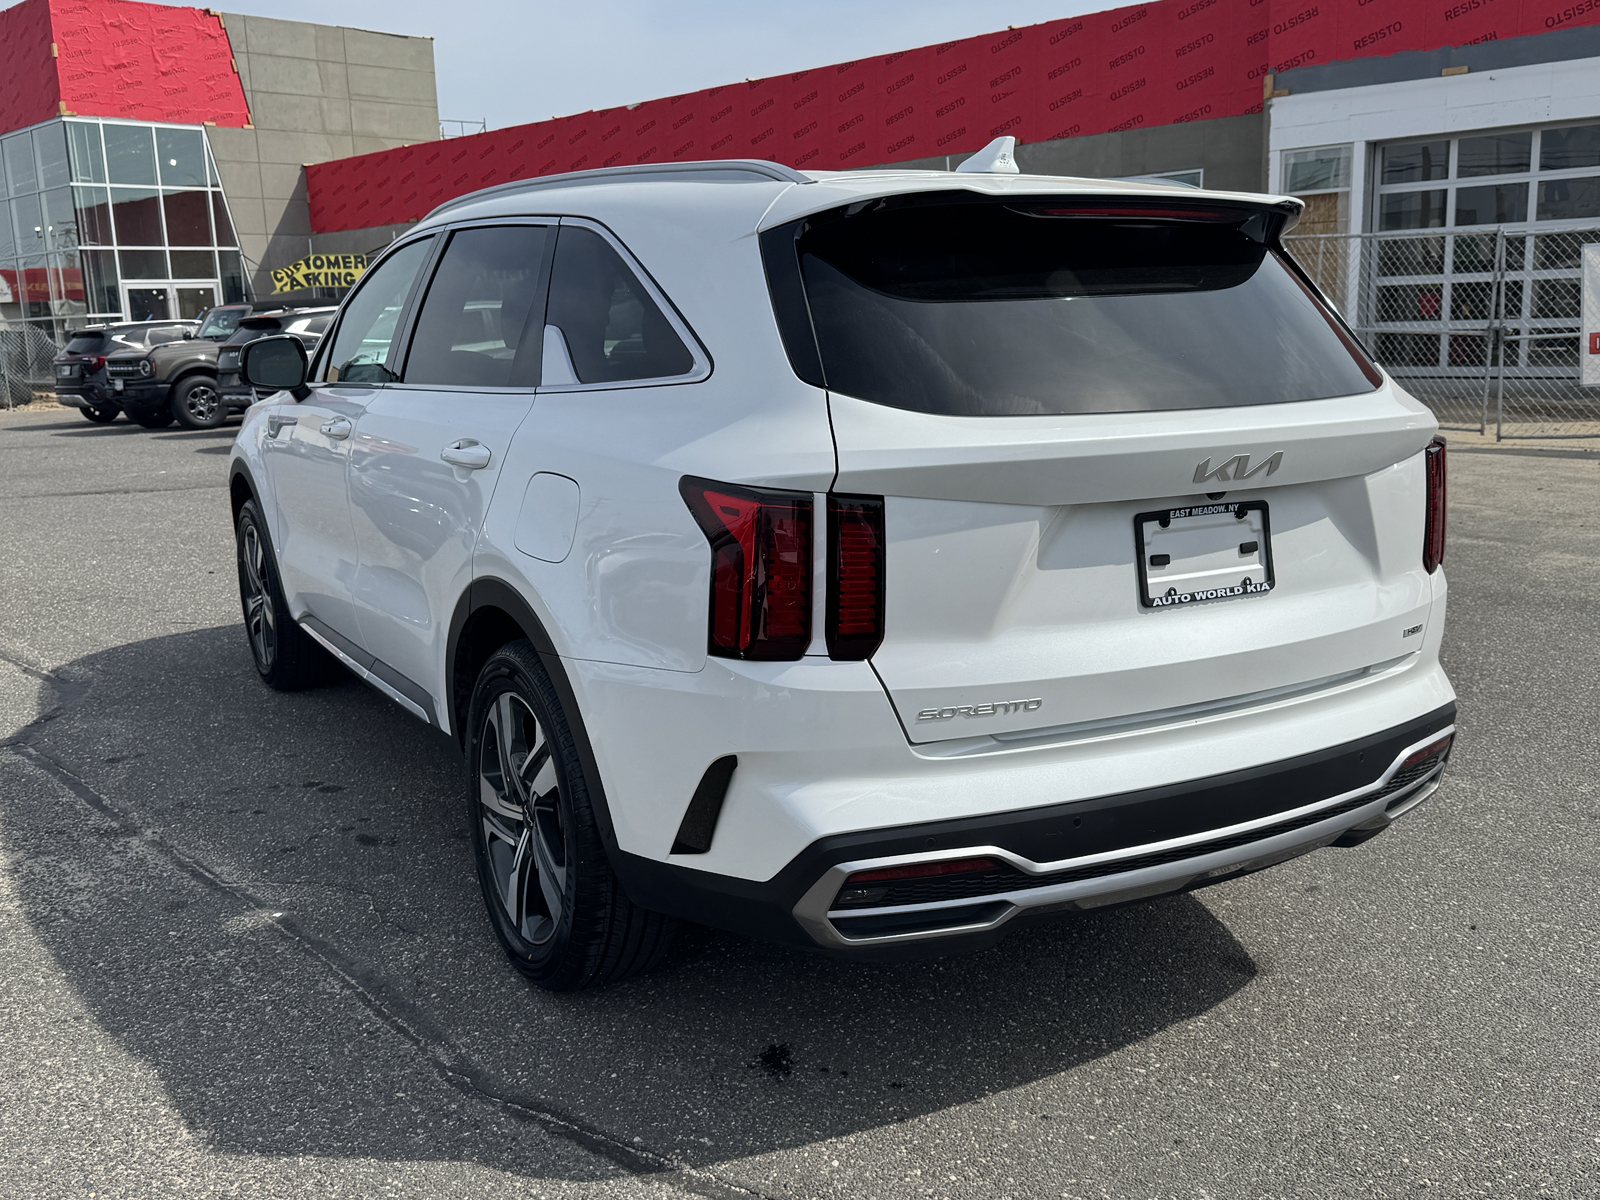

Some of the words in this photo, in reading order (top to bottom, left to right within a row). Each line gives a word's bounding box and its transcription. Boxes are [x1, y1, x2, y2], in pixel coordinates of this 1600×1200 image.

[1112, 8, 1148, 33] RESISTO
[1274, 6, 1320, 36] RESISTO
[990, 32, 1022, 54] RESISTO
[1050, 22, 1083, 46] RESISTO
[1354, 21, 1403, 50] RESISTO
[1176, 33, 1214, 58] RESISTO
[1109, 46, 1146, 70] RESISTO
[1274, 50, 1315, 73] ESISTO
[936, 63, 968, 85] RESISTO
[990, 66, 1022, 88] RESISTO
[1048, 58, 1082, 81] RESISTO
[1176, 66, 1214, 91] RESISTO
[838, 82, 864, 102] RESISTO
[886, 72, 914, 94] RESISTO
[1110, 78, 1146, 102] RESISTO
[793, 90, 818, 110] RESISTO
[936, 97, 966, 118] RESISTO
[1048, 88, 1082, 112] RESISTO
[838, 114, 864, 134] RESISTO
[886, 106, 914, 126] RESISTO
[990, 116, 1022, 138] RESISTO
[750, 128, 774, 146] RESISTO
[792, 121, 818, 140] RESISTO
[936, 126, 966, 148] RESISTO
[840, 141, 866, 161] RESISTO
[887, 134, 915, 154] RESISTO
[794, 148, 819, 166] RESISTO
[1192, 450, 1284, 484] KIA
[1170, 509, 1190, 518] EAST
[1228, 504, 1240, 512] NY
[1152, 594, 1191, 607] AUTO
[1194, 587, 1244, 602] WORLD
[1247, 582, 1271, 592] KIA
[918, 698, 1042, 720] SORENTO
